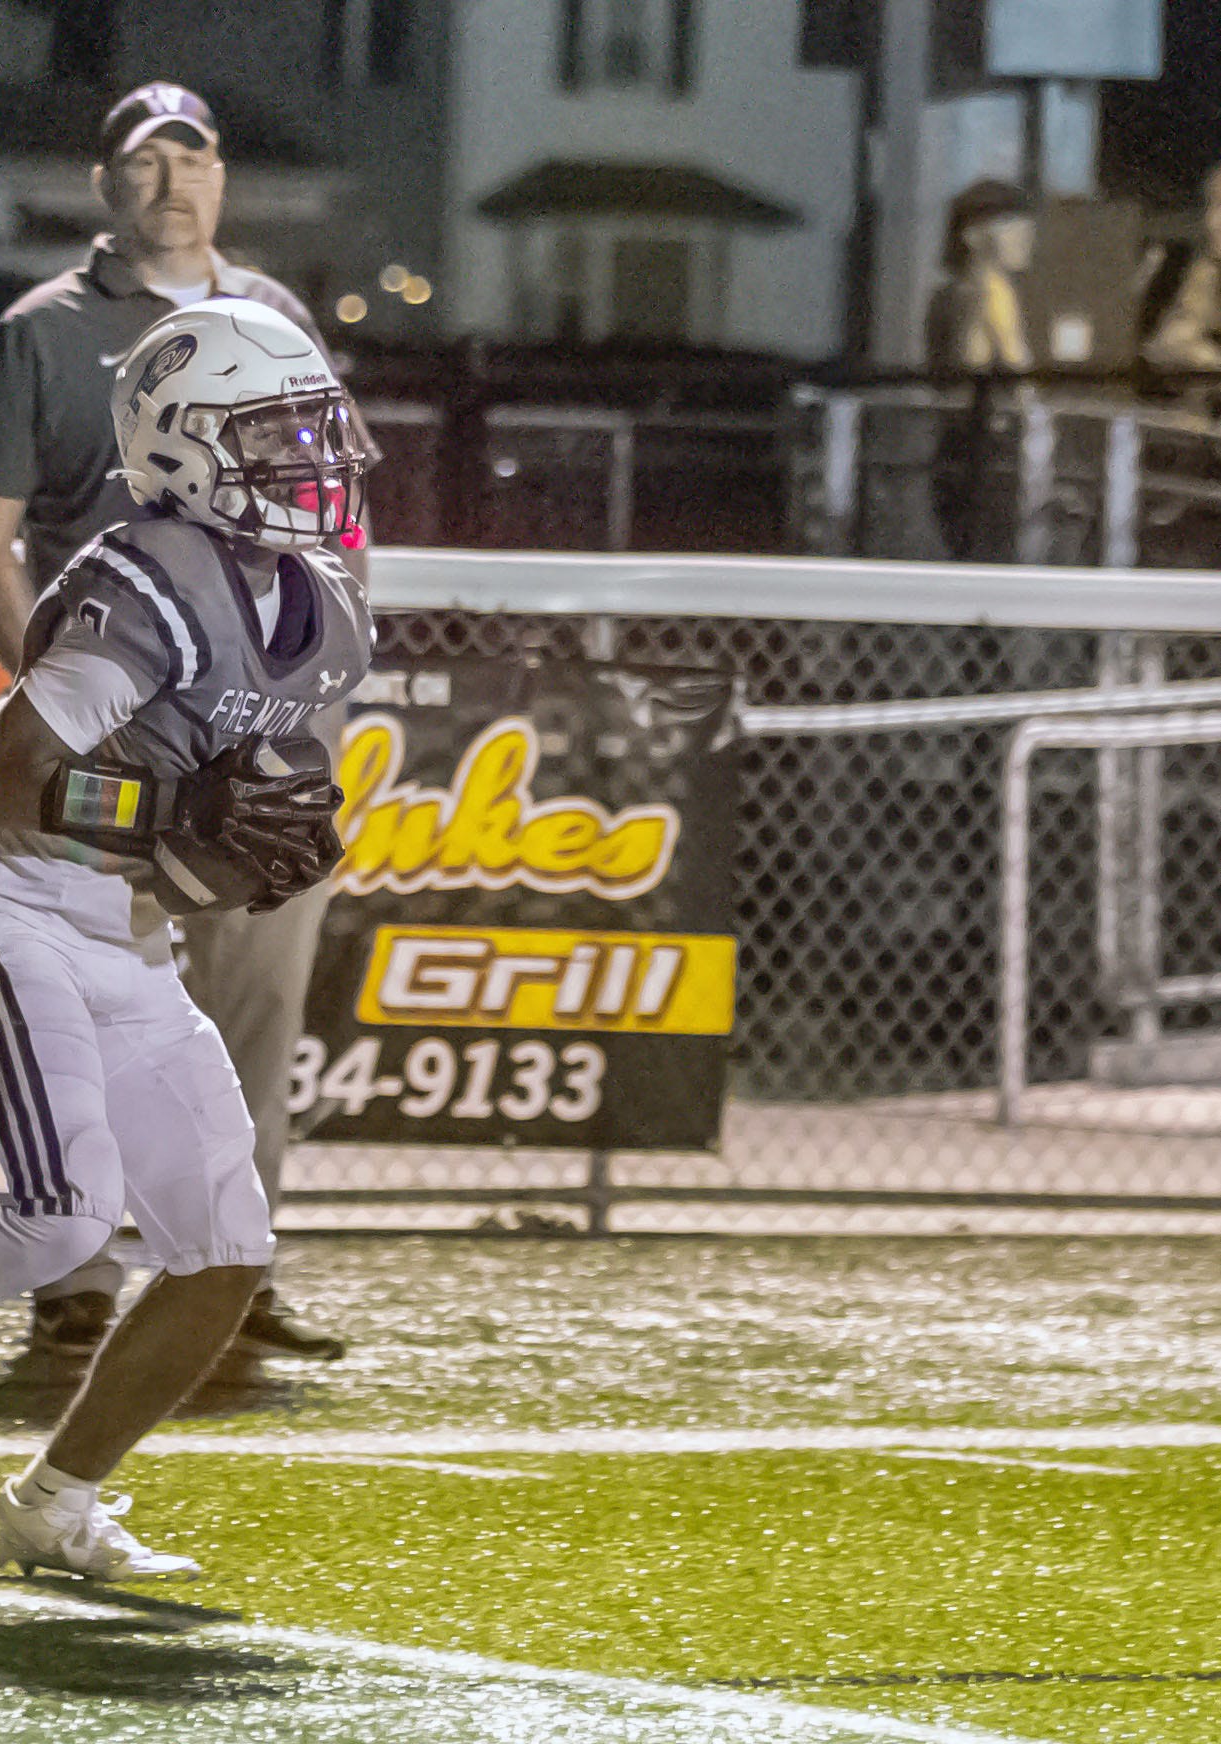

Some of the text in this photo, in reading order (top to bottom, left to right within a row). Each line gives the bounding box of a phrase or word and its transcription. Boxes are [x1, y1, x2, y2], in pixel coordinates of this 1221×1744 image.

[288, 373, 328, 387] Riddell
[207, 688, 327, 737] FREMON
[377, 936, 684, 1019] Grill
[282, 1034, 608, 1122] 34-9133
